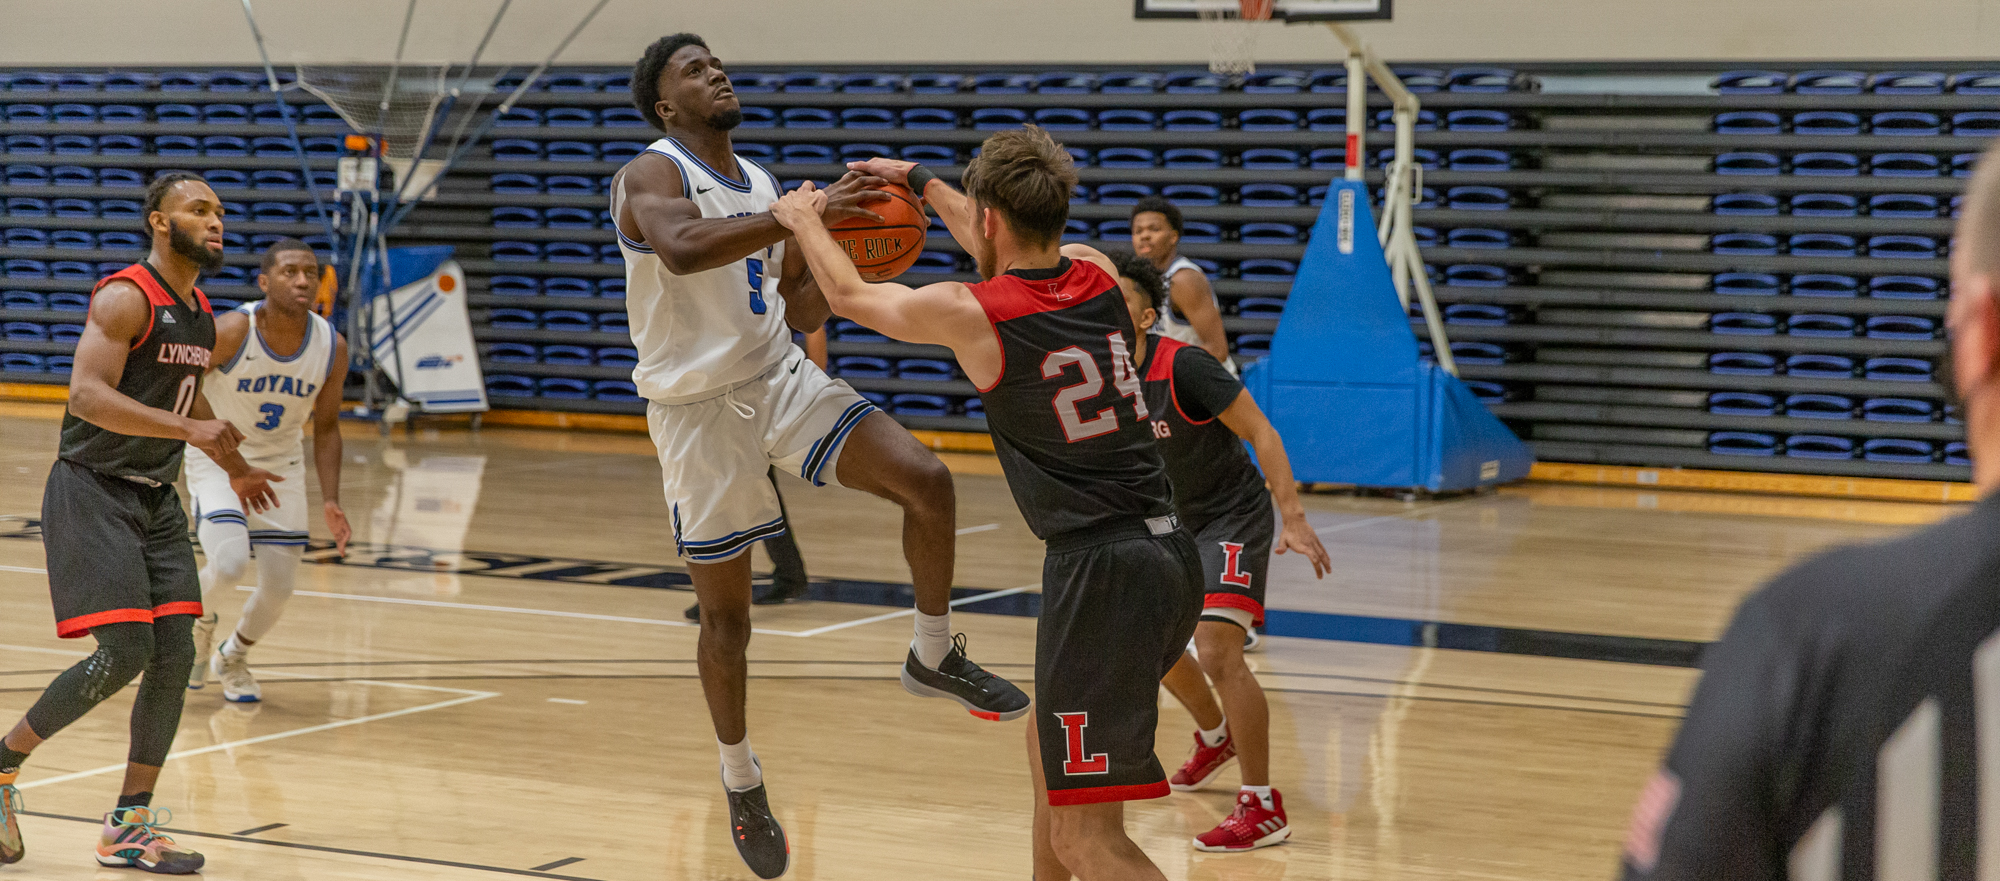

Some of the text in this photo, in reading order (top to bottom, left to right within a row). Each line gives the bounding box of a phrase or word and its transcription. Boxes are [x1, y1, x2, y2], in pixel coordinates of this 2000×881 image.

[864, 238, 903, 260] ROCK
[746, 257, 767, 315] 5
[157, 343, 212, 368] LYNCHBUR
[236, 374, 316, 397] ROYALS
[1040, 330, 1149, 443] 24
[255, 403, 284, 431] 3
[1218, 541, 1252, 589] L
[1053, 711, 1109, 776] L
